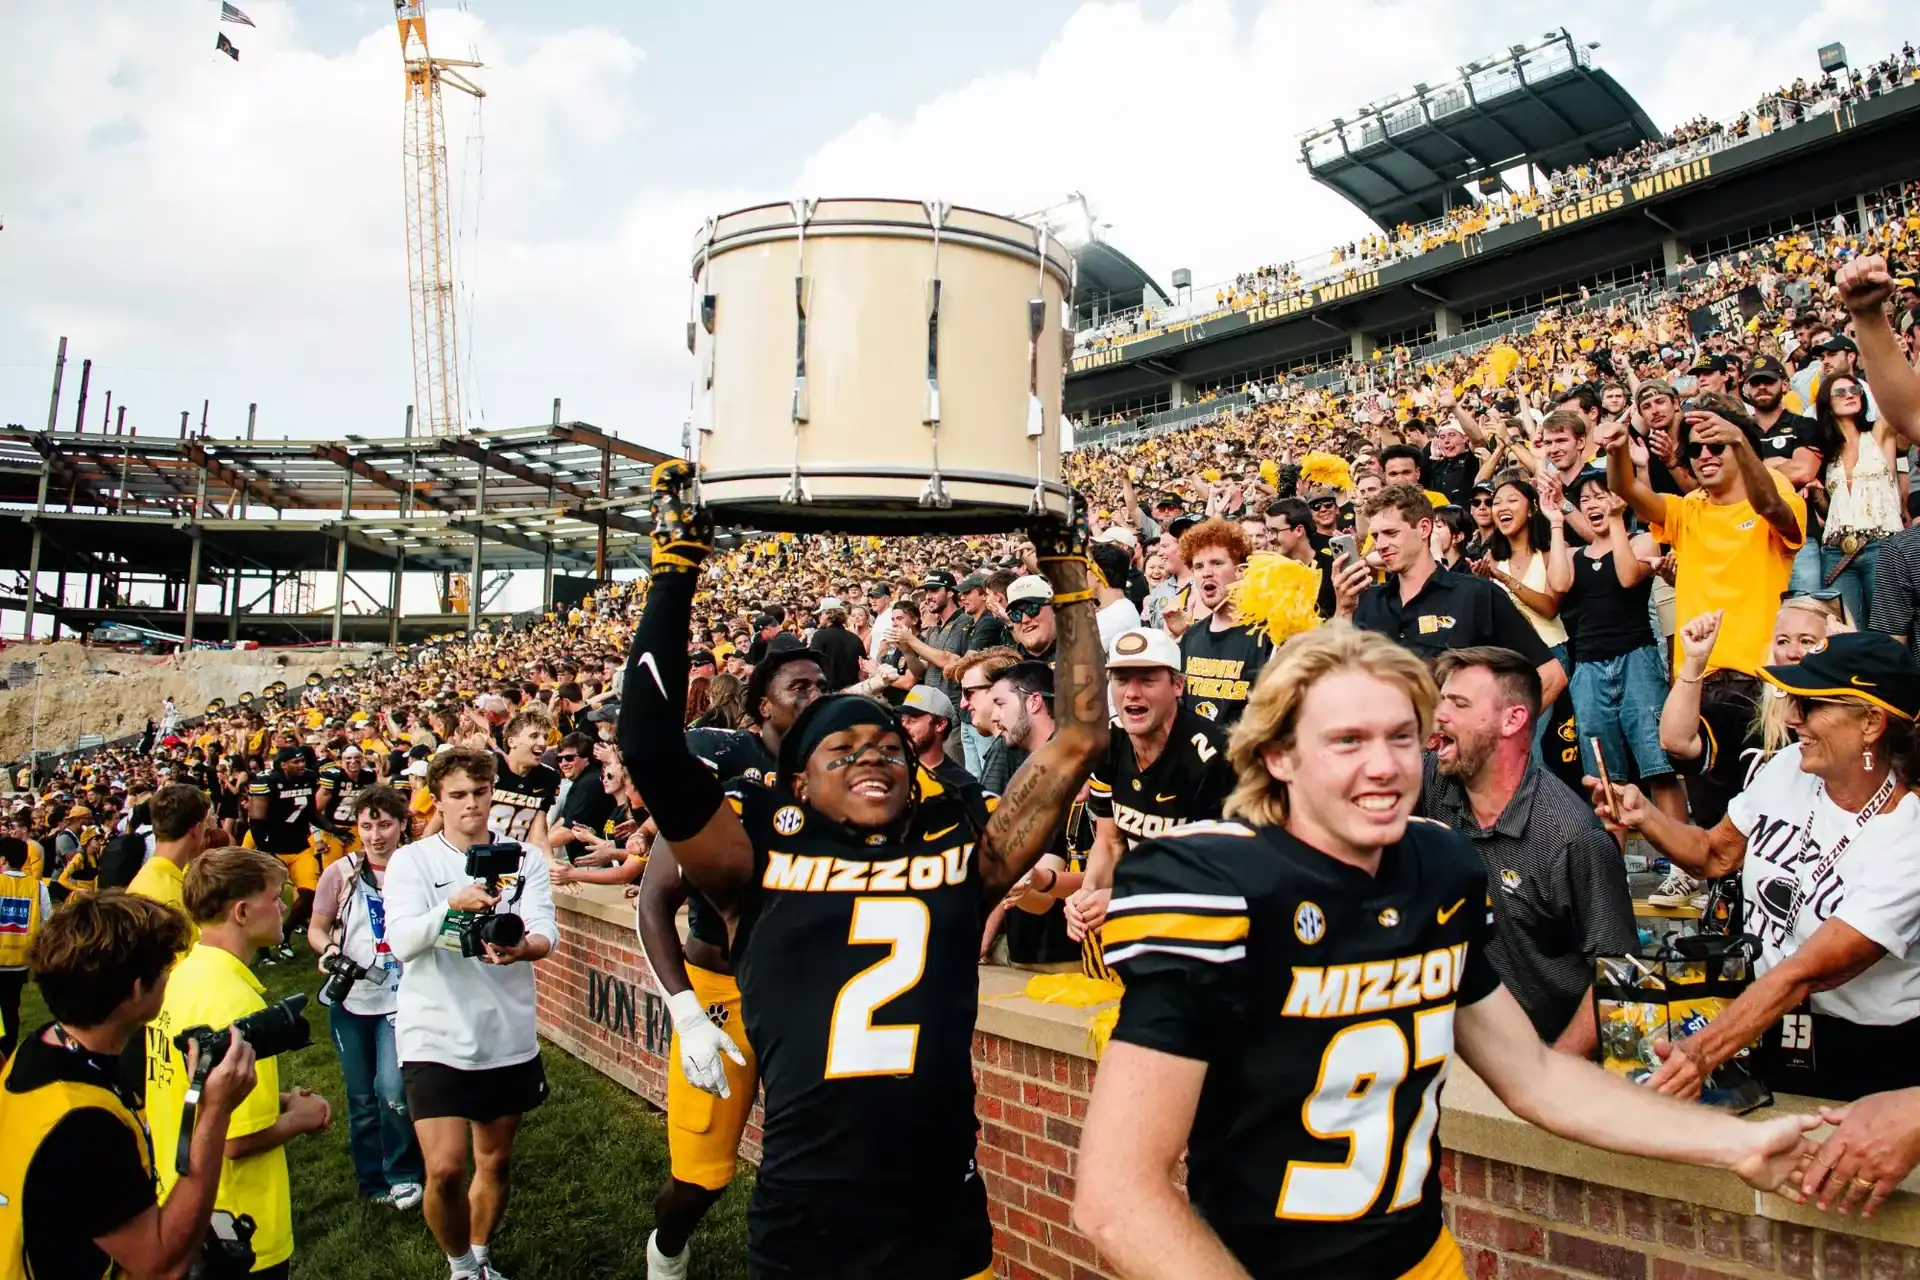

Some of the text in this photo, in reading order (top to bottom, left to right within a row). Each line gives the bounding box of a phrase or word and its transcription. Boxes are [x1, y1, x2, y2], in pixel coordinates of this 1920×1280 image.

[1537, 156, 1712, 232] TIGERS WIN!!!
[1247, 270, 1380, 325] TIGERS WIN!!!
[1072, 347, 1124, 372] WIN!!!
[1190, 732, 1218, 763] 2
[285, 796, 308, 824] 7
[776, 807, 804, 834] SEC
[1855, 779, 1894, 828] MIZZOU
[762, 842, 976, 892] MIZZOU
[1811, 834, 1851, 883] MIZZOU
[1297, 904, 1323, 940] SEC
[587, 967, 672, 1057] DON FA
[824, 896, 931, 1080] 2
[1781, 1014, 1813, 1049] 53
[1275, 1001, 1456, 1222] 97
